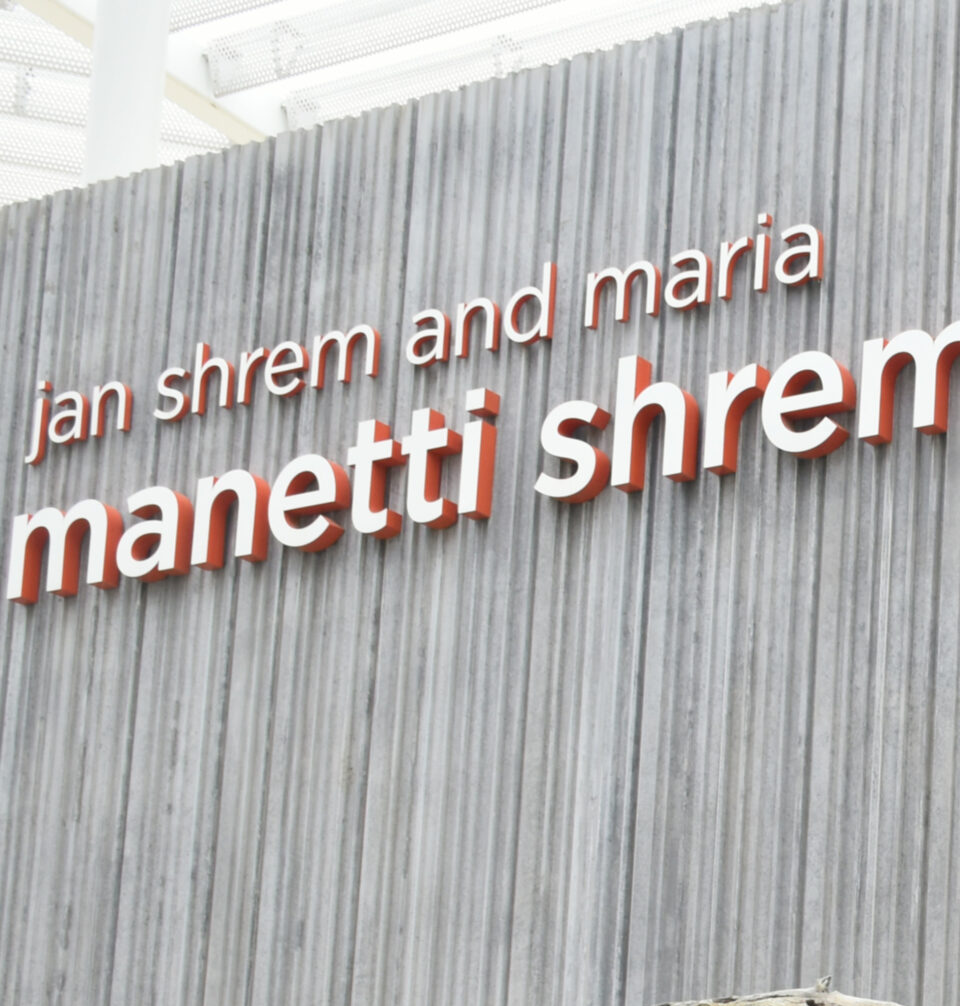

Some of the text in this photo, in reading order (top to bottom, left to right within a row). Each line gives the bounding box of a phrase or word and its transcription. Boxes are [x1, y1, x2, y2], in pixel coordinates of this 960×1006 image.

[25, 213, 824, 465] jan shrem and maria
[6, 388, 501, 605] manetti
